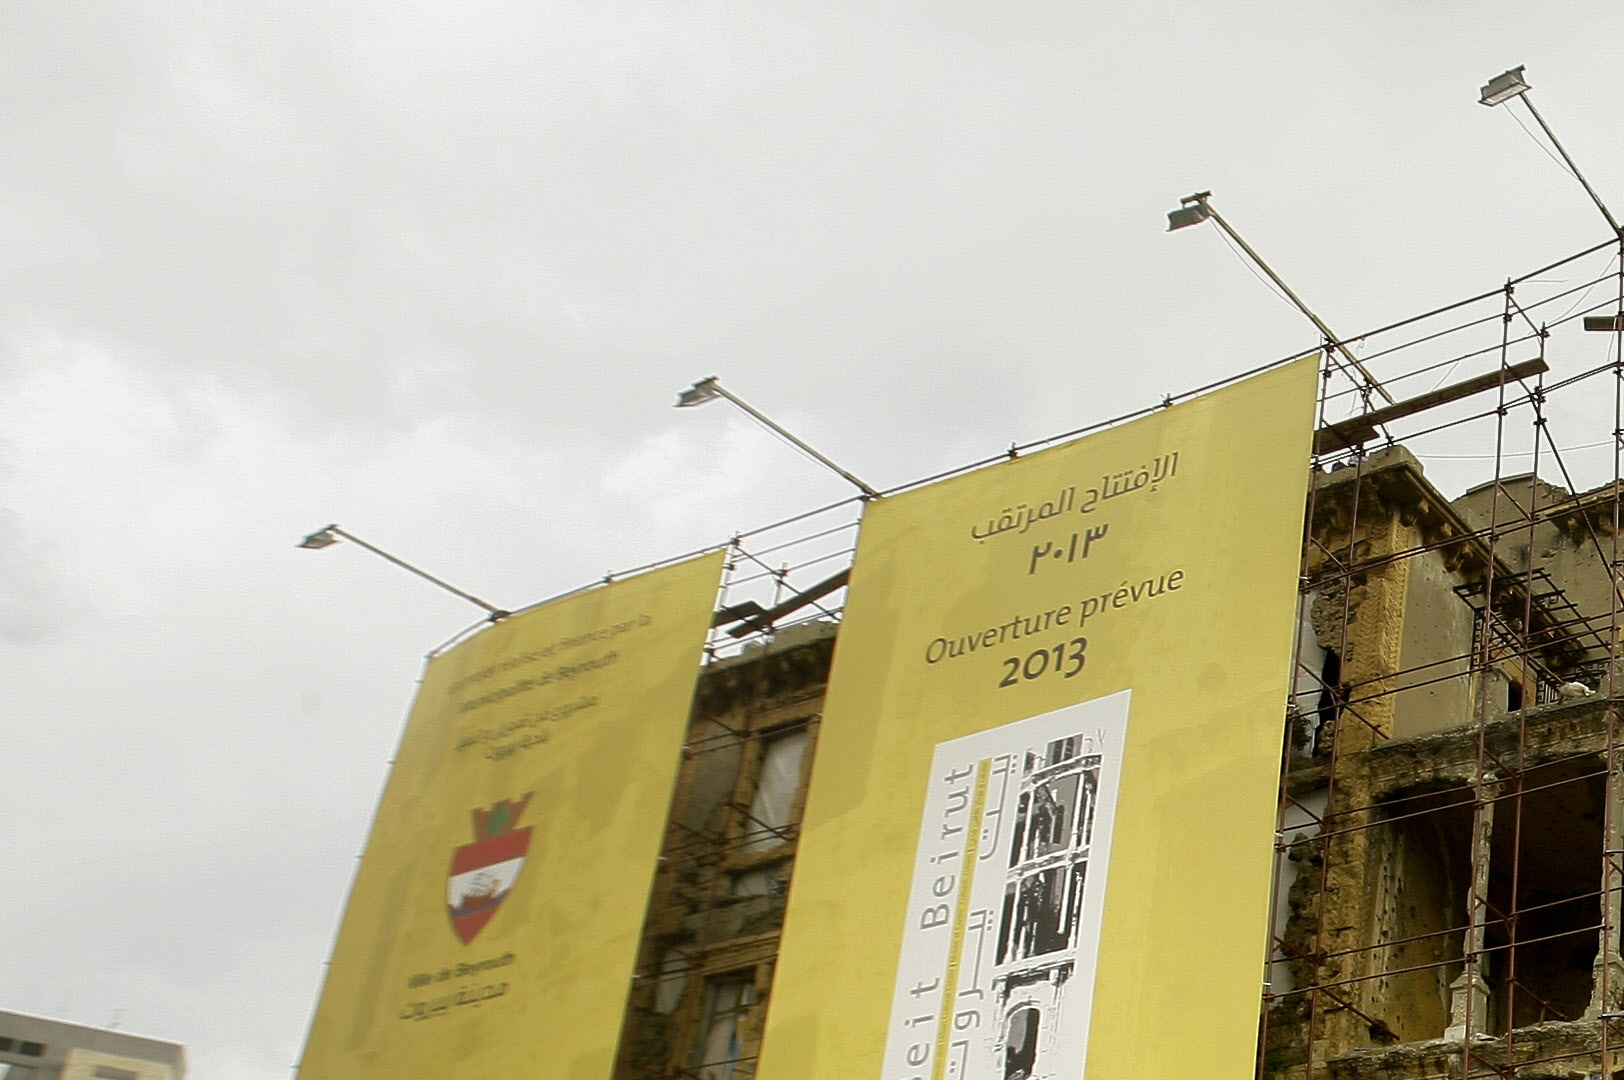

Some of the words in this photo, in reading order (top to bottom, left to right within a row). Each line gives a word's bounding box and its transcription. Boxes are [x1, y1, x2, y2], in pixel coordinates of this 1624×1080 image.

[1079, 451, 1179, 514] الإفتتاح
[971, 487, 1076, 544] المرتقب
[1029, 523, 1110, 574] ٢٠١٣
[925, 602, 1072, 664] Ouverture
[1079, 569, 1185, 628] prévue
[998, 636, 1088, 688] 2013
[920, 762, 975, 930] Beirut
